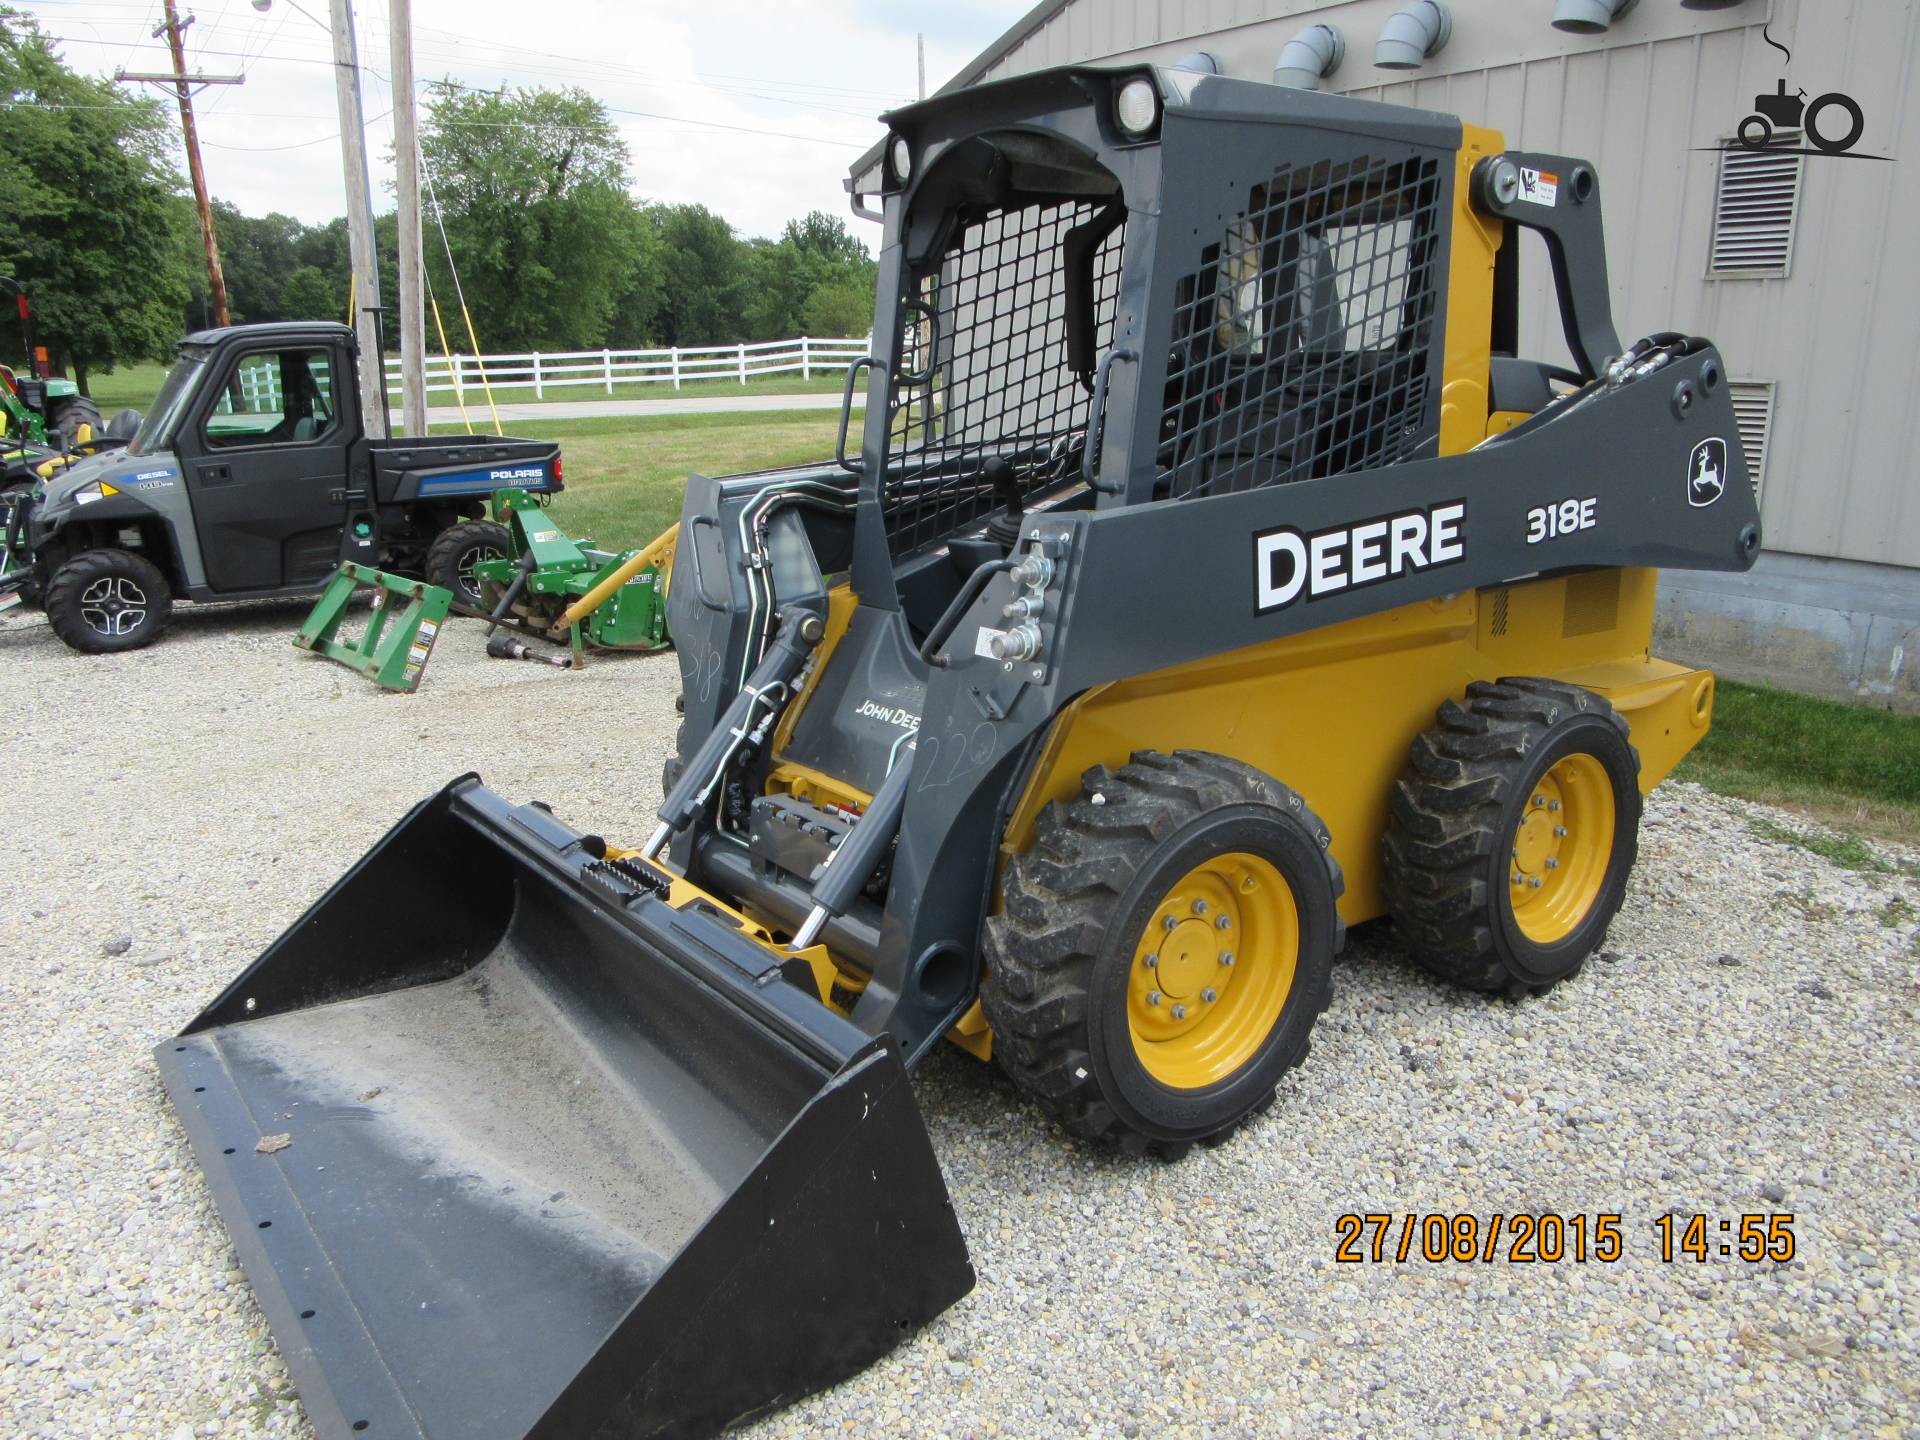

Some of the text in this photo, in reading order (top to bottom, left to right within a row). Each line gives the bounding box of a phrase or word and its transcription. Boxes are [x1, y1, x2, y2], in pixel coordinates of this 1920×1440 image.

[137, 470, 172, 481] DIESEL
[490, 469, 544, 480] POLARIS
[1527, 497, 1597, 544] 318E
[1256, 503, 1465, 611] DEERE
[855, 699, 893, 722] JOHN
